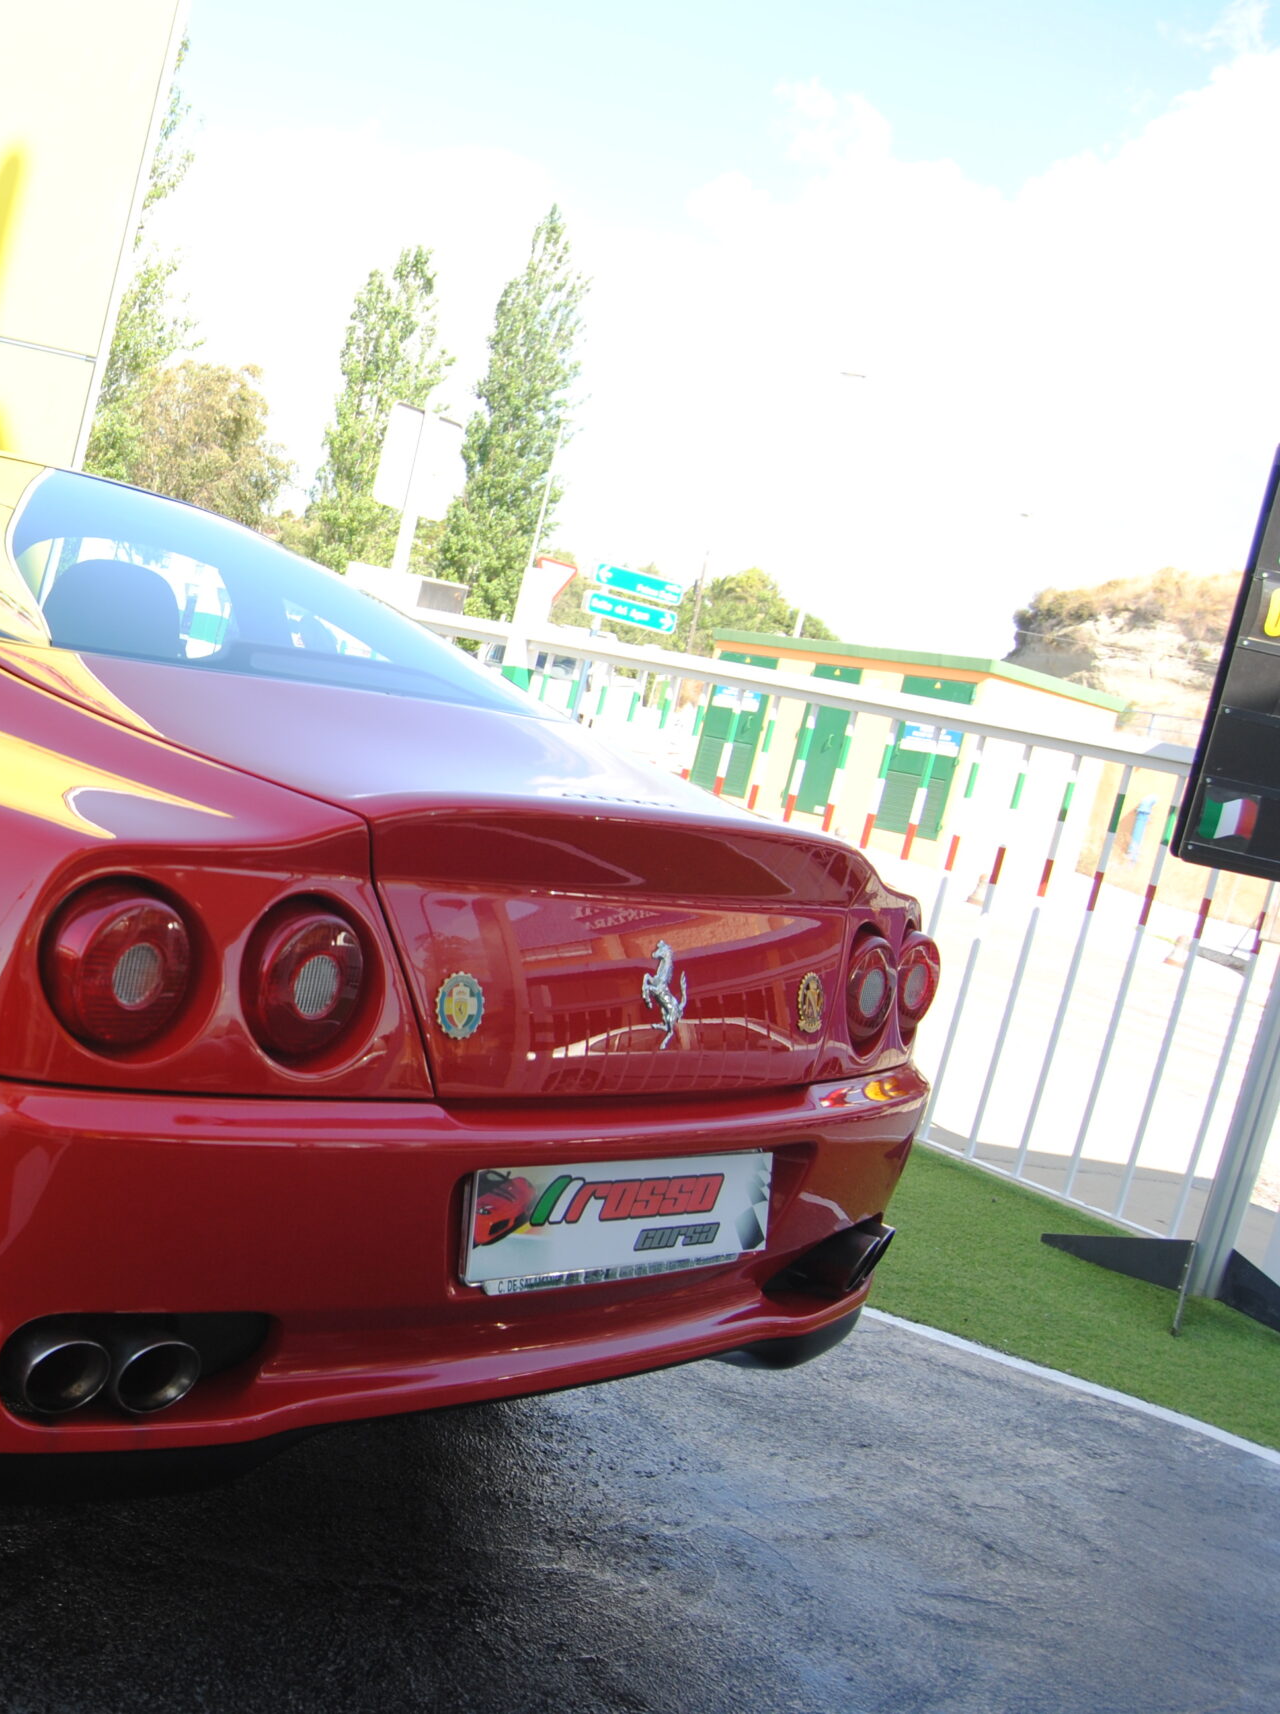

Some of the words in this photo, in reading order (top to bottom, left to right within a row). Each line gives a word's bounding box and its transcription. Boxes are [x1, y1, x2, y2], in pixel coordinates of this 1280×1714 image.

[564, 1173, 725, 1223] rosso
[633, 1222, 721, 1252] corsa
[507, 1279, 518, 1293] DE
